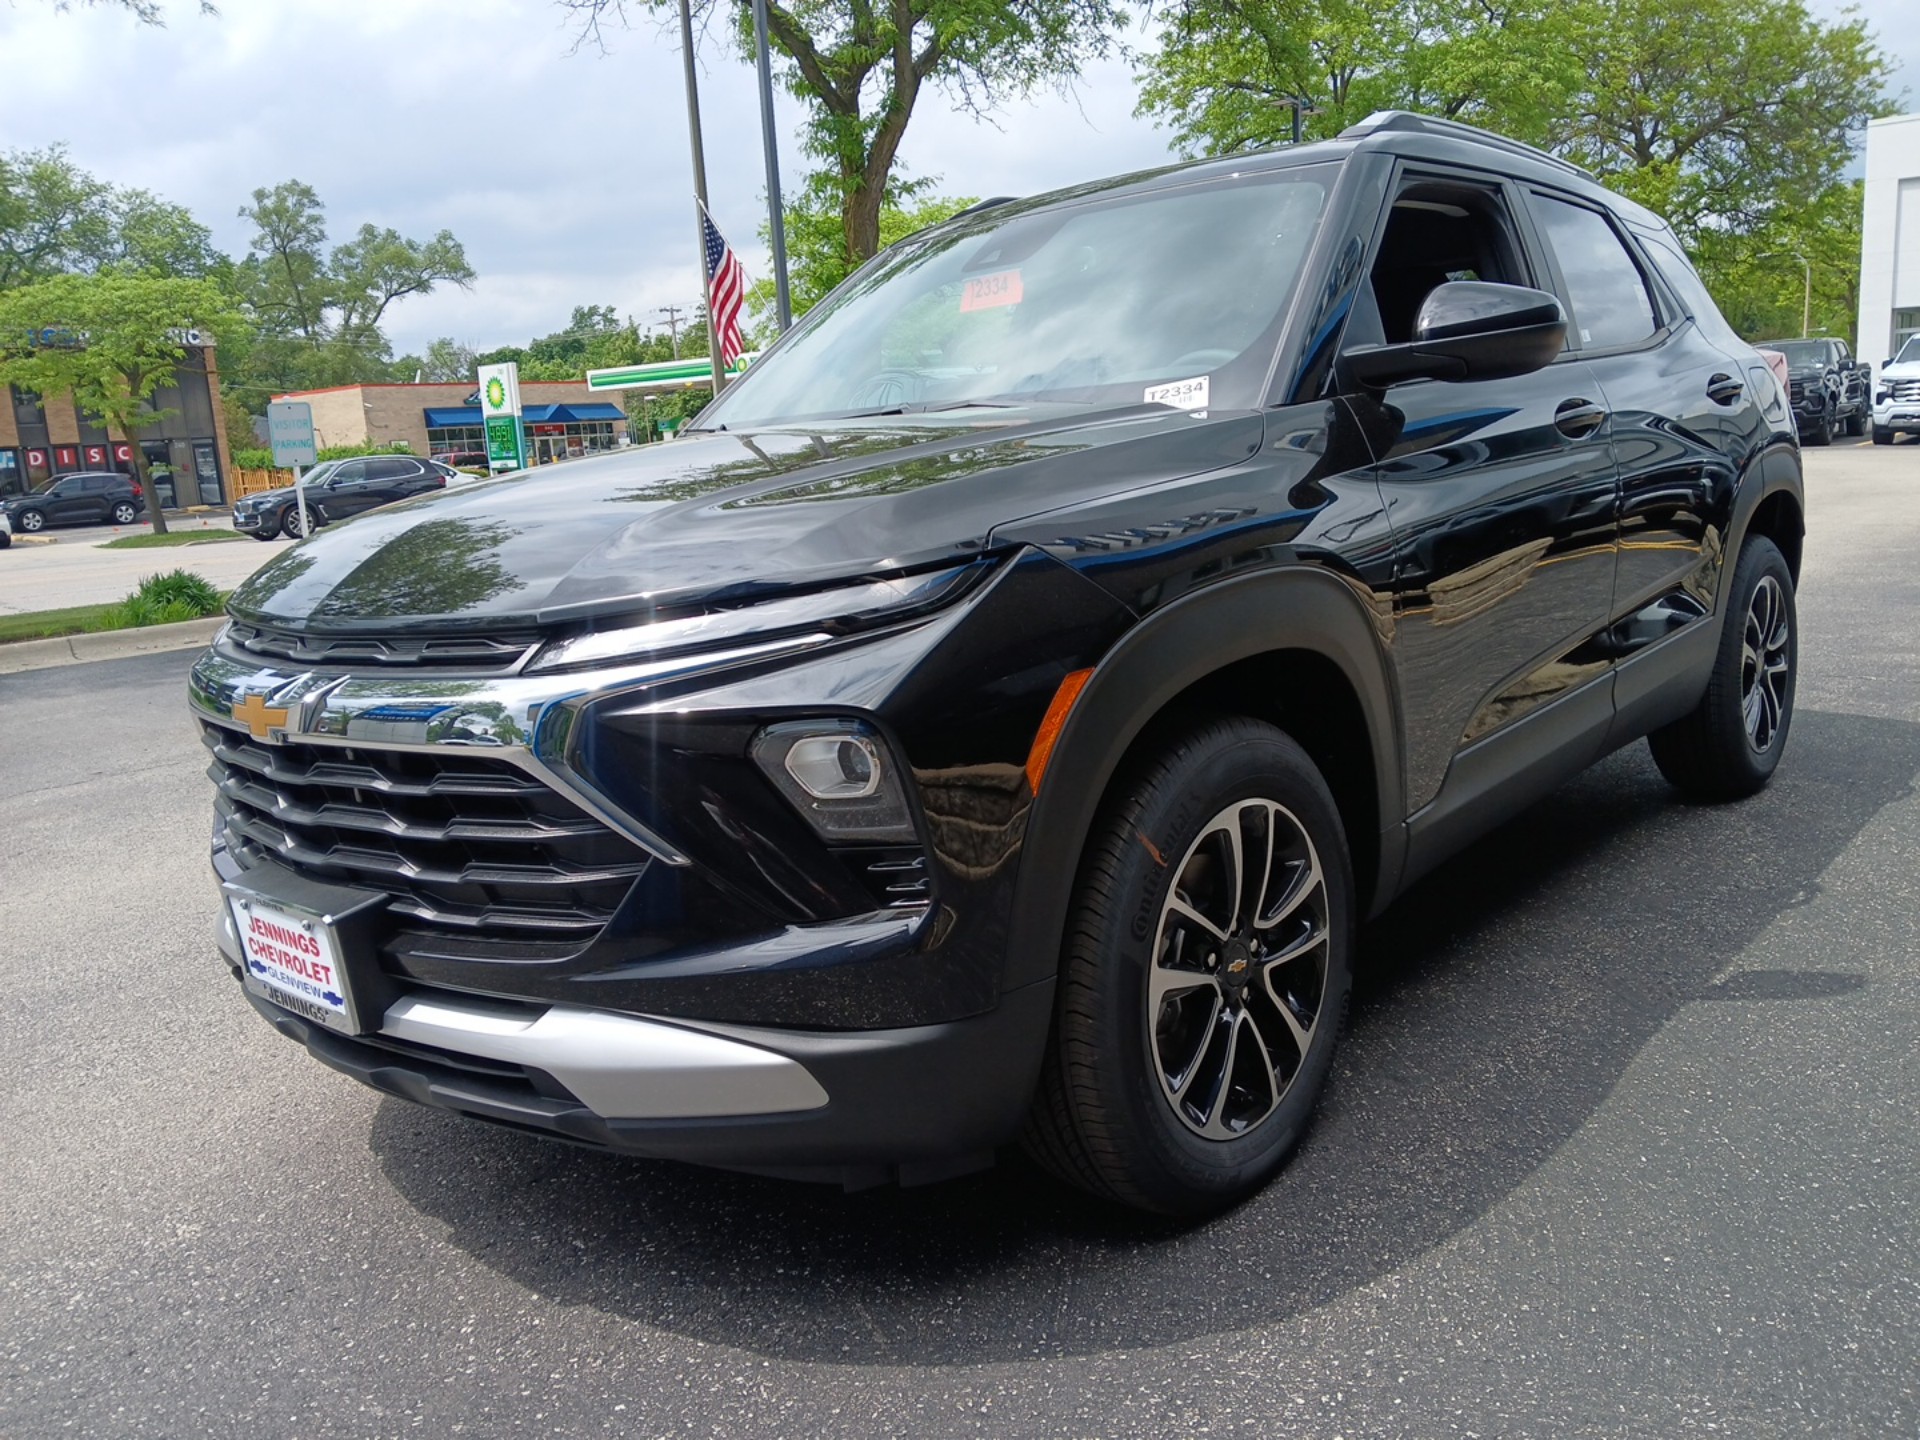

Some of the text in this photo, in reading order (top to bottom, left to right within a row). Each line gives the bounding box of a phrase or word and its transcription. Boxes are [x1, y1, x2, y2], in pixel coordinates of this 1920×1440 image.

[1148, 382, 1203, 401] T2334
[273, 418, 309, 430] VISITOR
[273, 438, 313, 449] PARKING
[248, 916, 321, 957] JENNINGS
[248, 937, 331, 985] CHEVROLET
[267, 966, 321, 998] GLENVIEW
